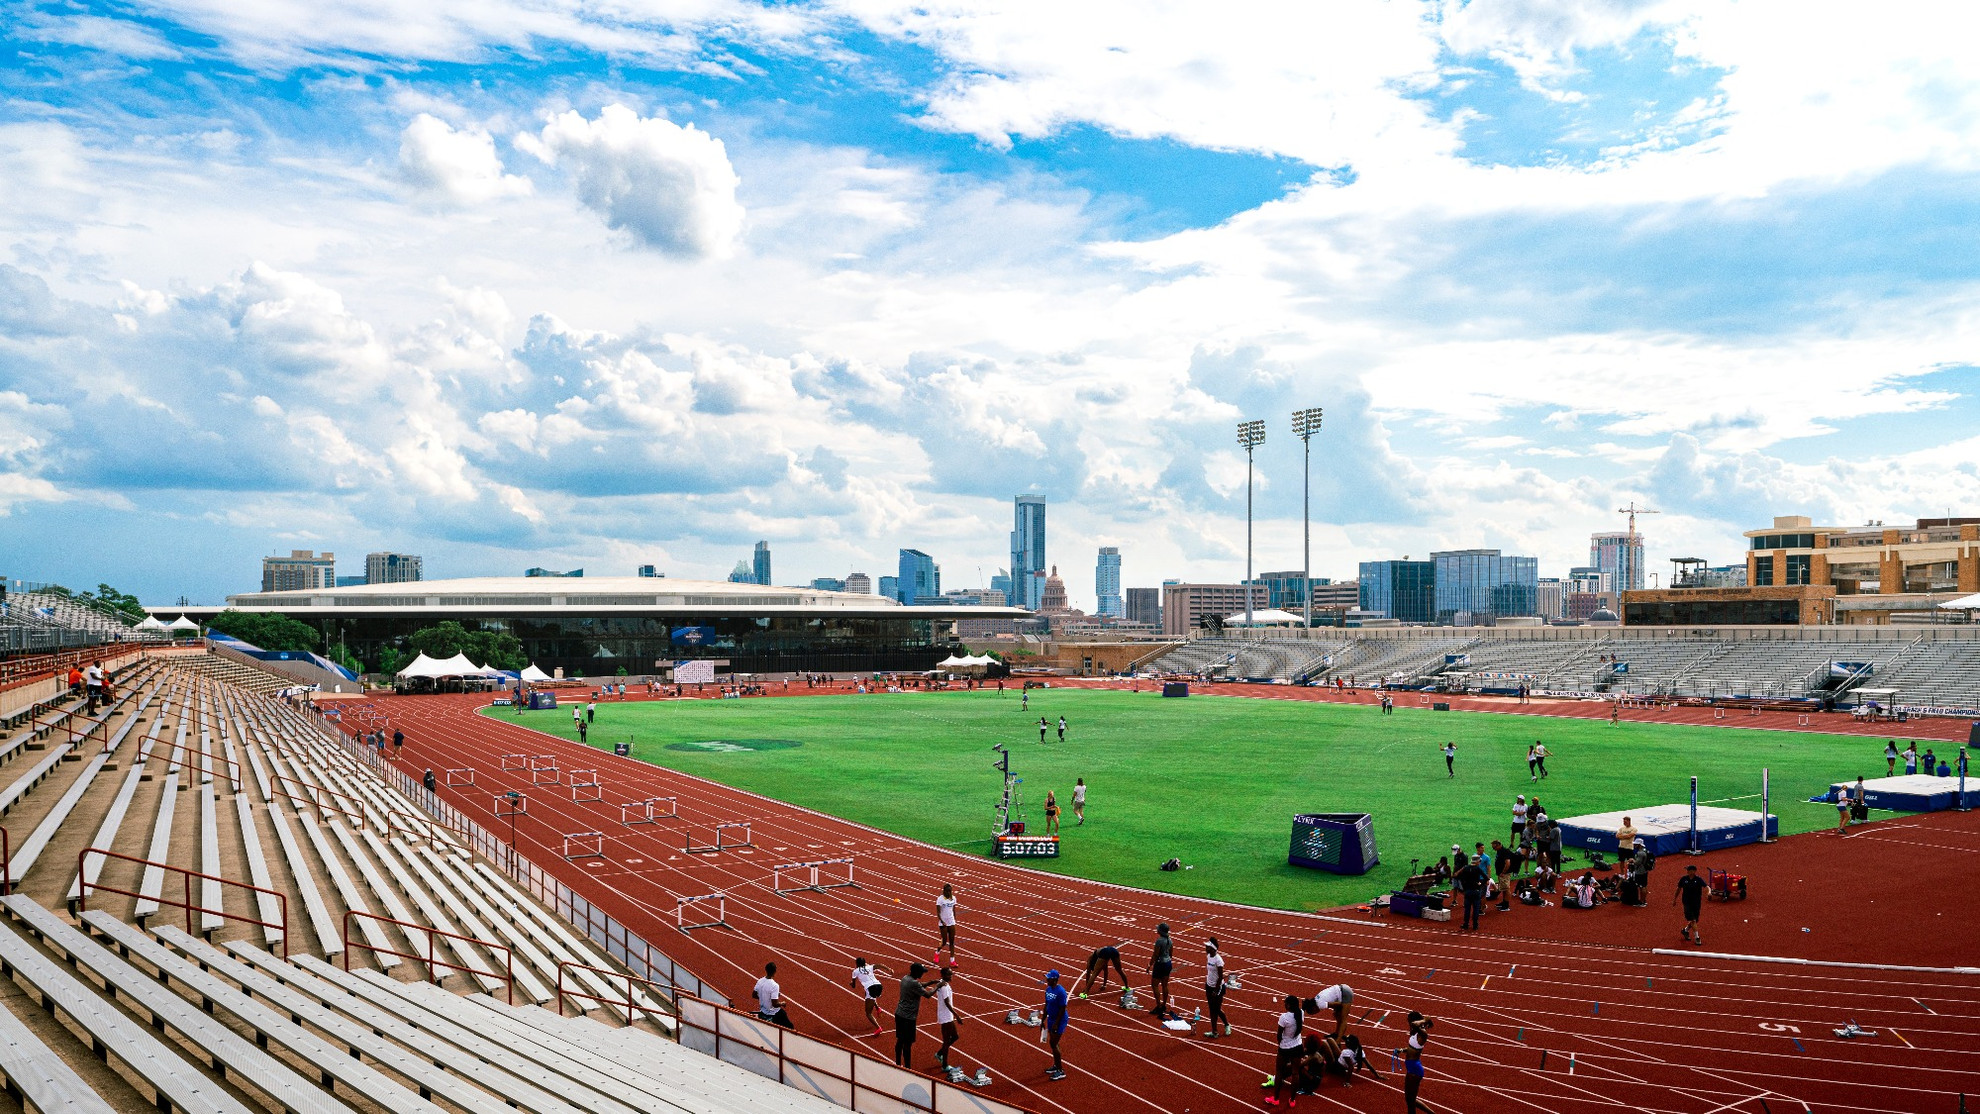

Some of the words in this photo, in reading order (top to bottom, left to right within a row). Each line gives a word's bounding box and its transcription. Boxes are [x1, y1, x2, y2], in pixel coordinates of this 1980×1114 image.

[1297, 816, 1315, 825] LYNX
[1002, 842, 1056, 855] 5:07:03
[1757, 1022, 1802, 1034] 5
